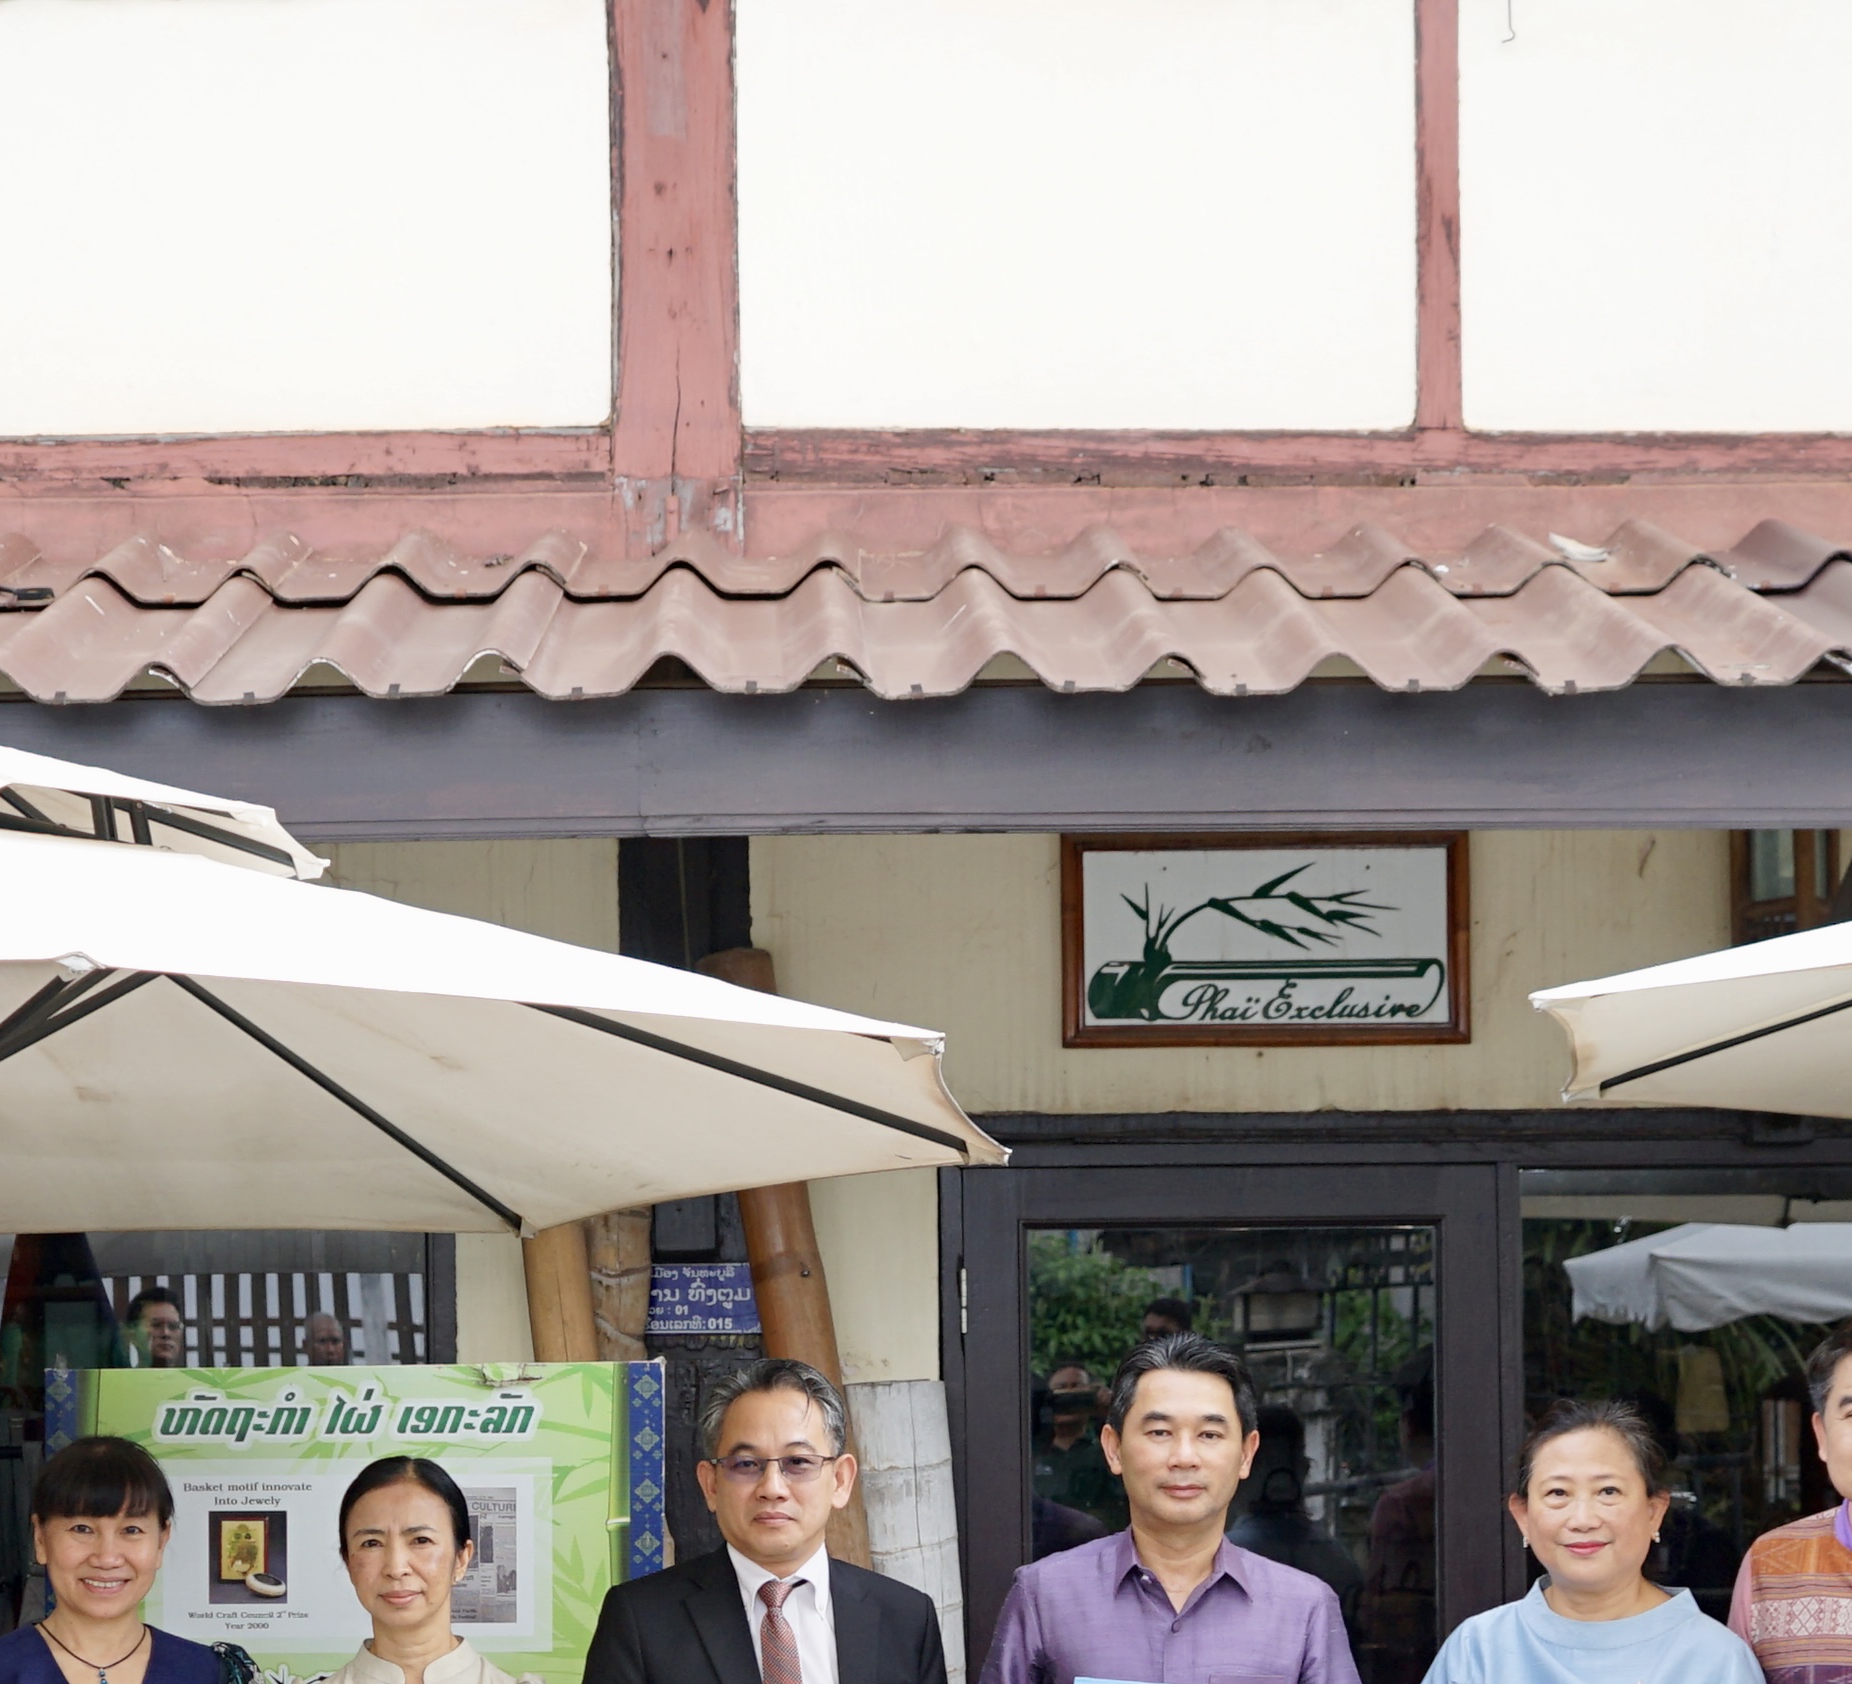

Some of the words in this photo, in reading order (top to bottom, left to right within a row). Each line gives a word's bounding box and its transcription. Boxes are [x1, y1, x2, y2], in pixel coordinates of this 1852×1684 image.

[1262, 978, 1427, 1020] Exclusive
[651, 1287, 680, 1301] ານ
[675, 1304, 688, 1315] 01
[397, 1392, 536, 1435] ເອກະລັກ
[183, 1482, 223, 1493] Basket
[227, 1482, 259, 1492] motif
[262, 1482, 313, 1492] innovate
[214, 1496, 238, 1506] Into
[240, 1496, 281, 1507] Jewely
[187, 1611, 213, 1619] World
[215, 1611, 238, 1619] Craft
[240, 1611, 274, 1619] Council
[225, 1622, 245, 1630] Year
[246, 1622, 270, 1630] 2000
